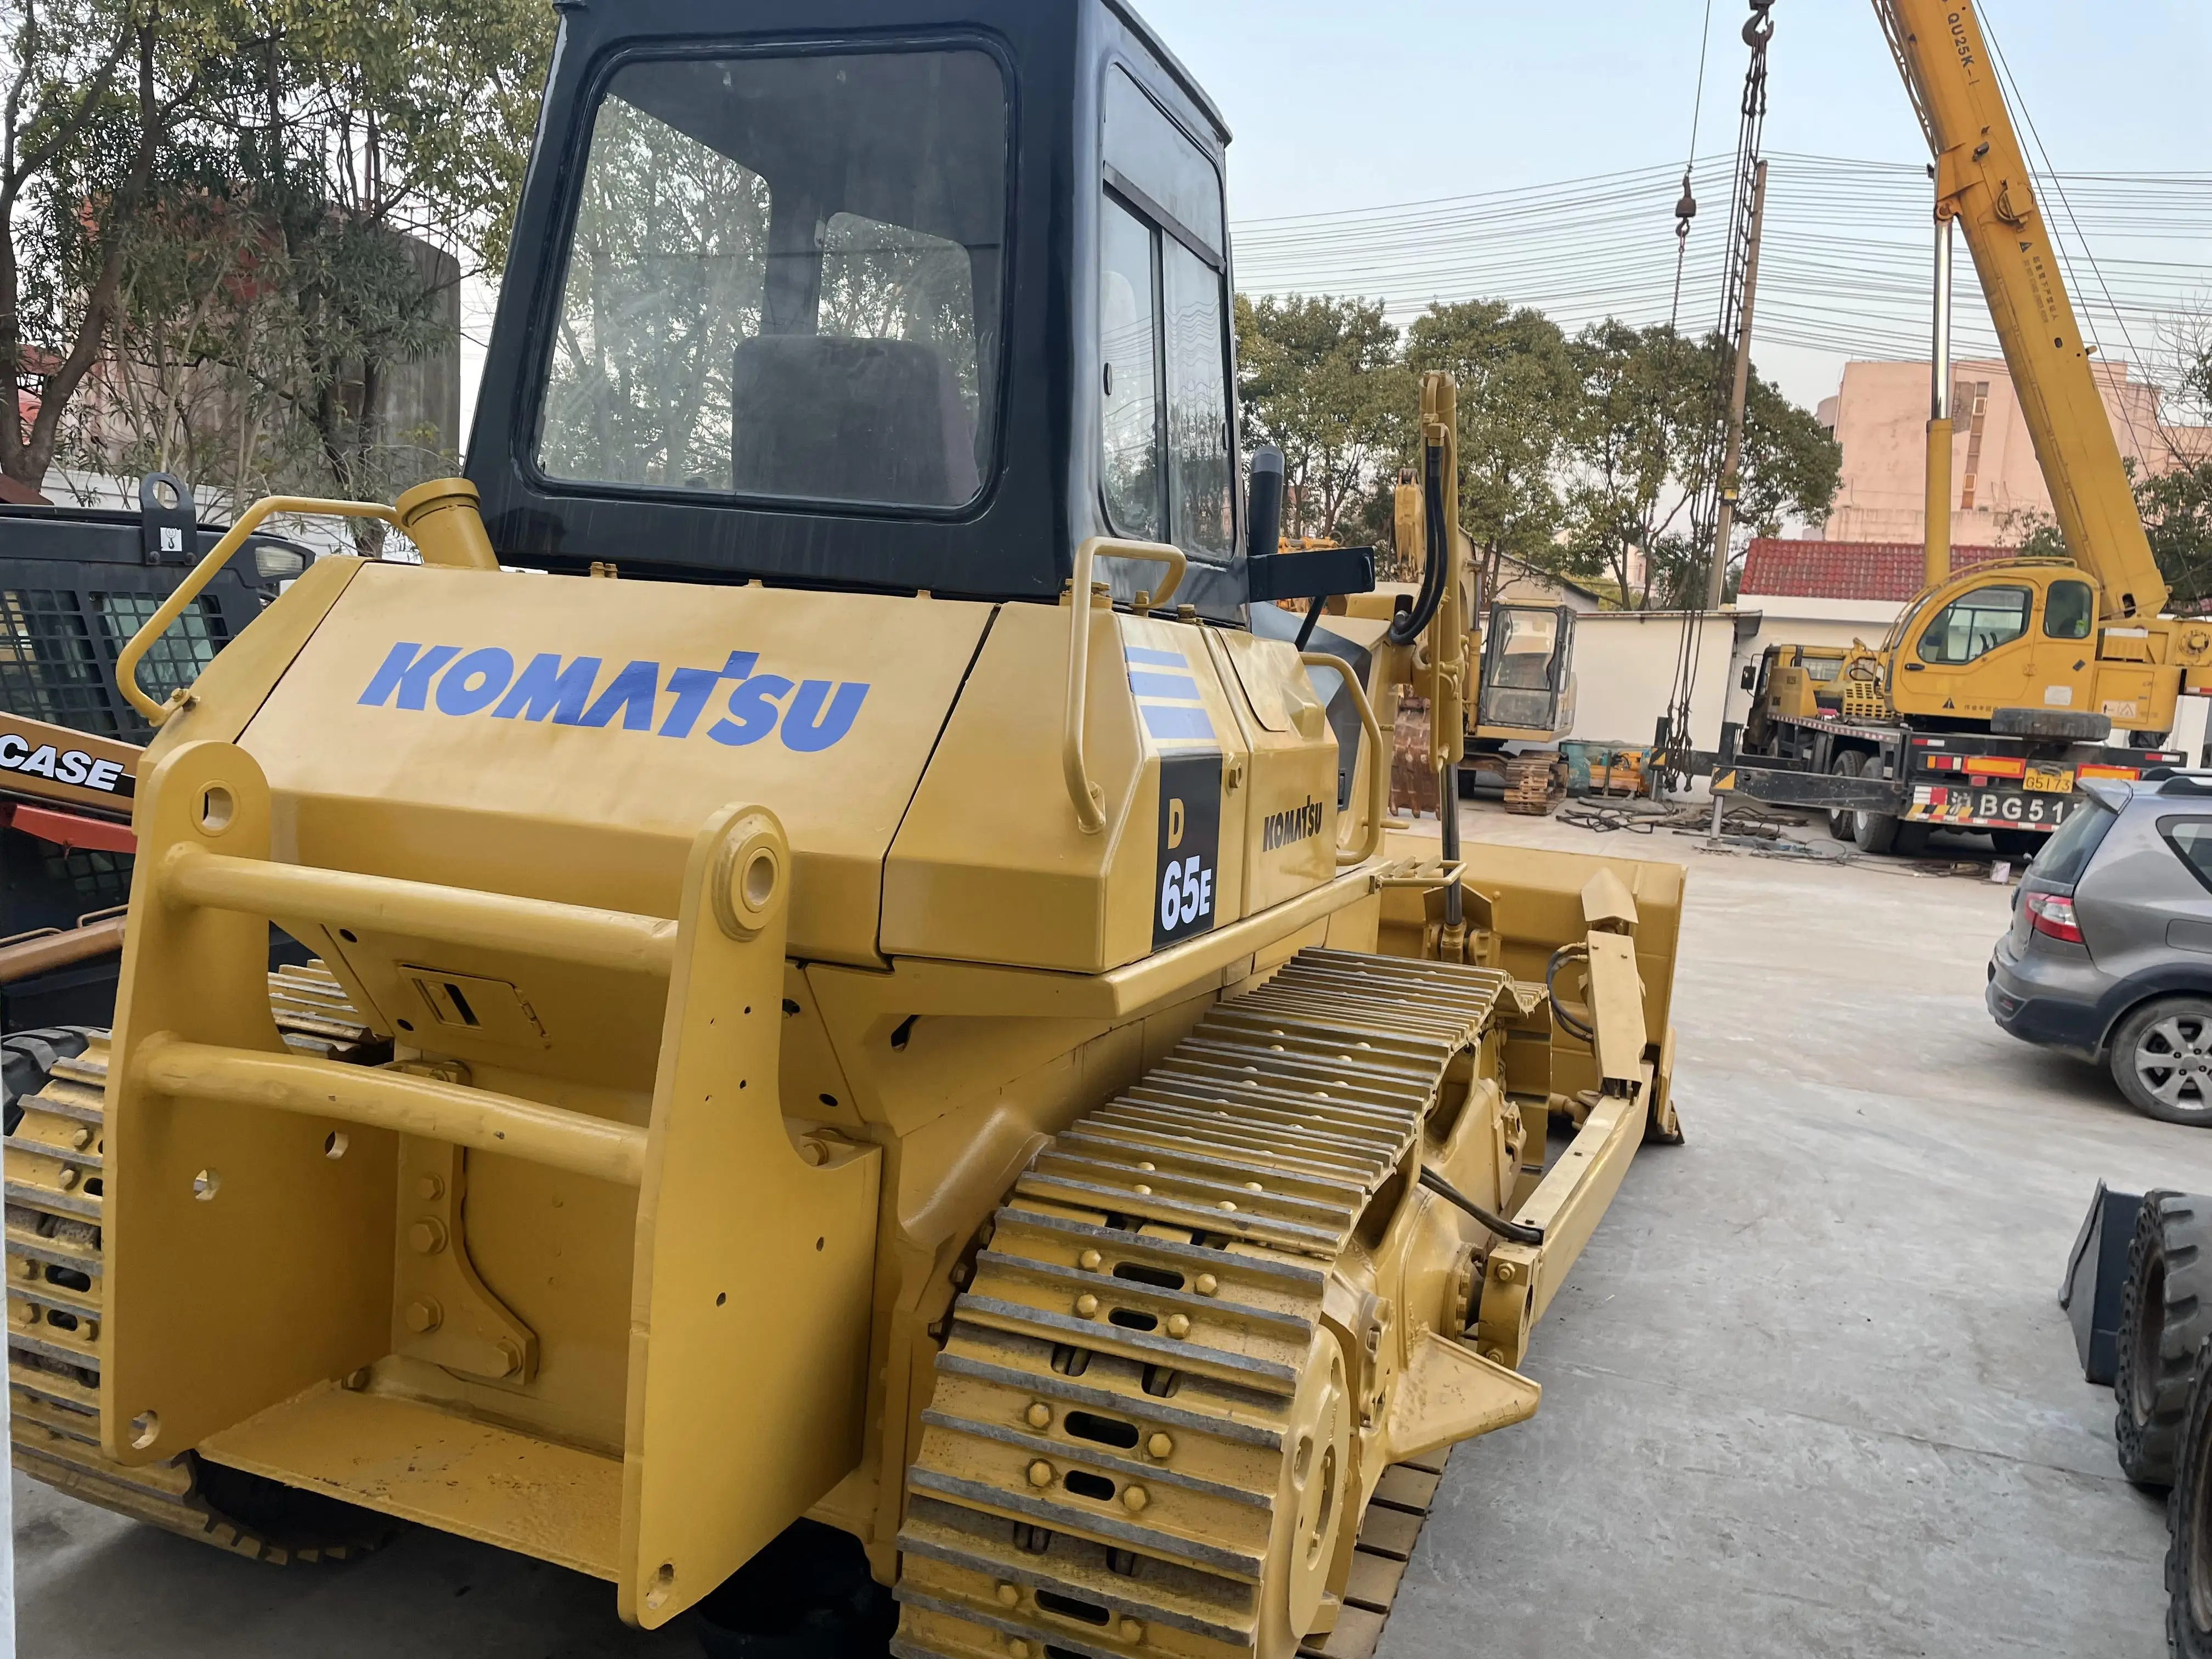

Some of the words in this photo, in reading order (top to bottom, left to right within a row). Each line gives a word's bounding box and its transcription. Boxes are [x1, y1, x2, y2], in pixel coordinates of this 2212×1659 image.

[357, 642, 870, 752] KOMATSU
[0, 735, 124, 791] CASE
[2026, 776, 2071, 791] G5173
[1168, 798, 1184, 849] D
[1263, 795, 1322, 852] KOMATSU
[1161, 855, 1211, 930] 65E
